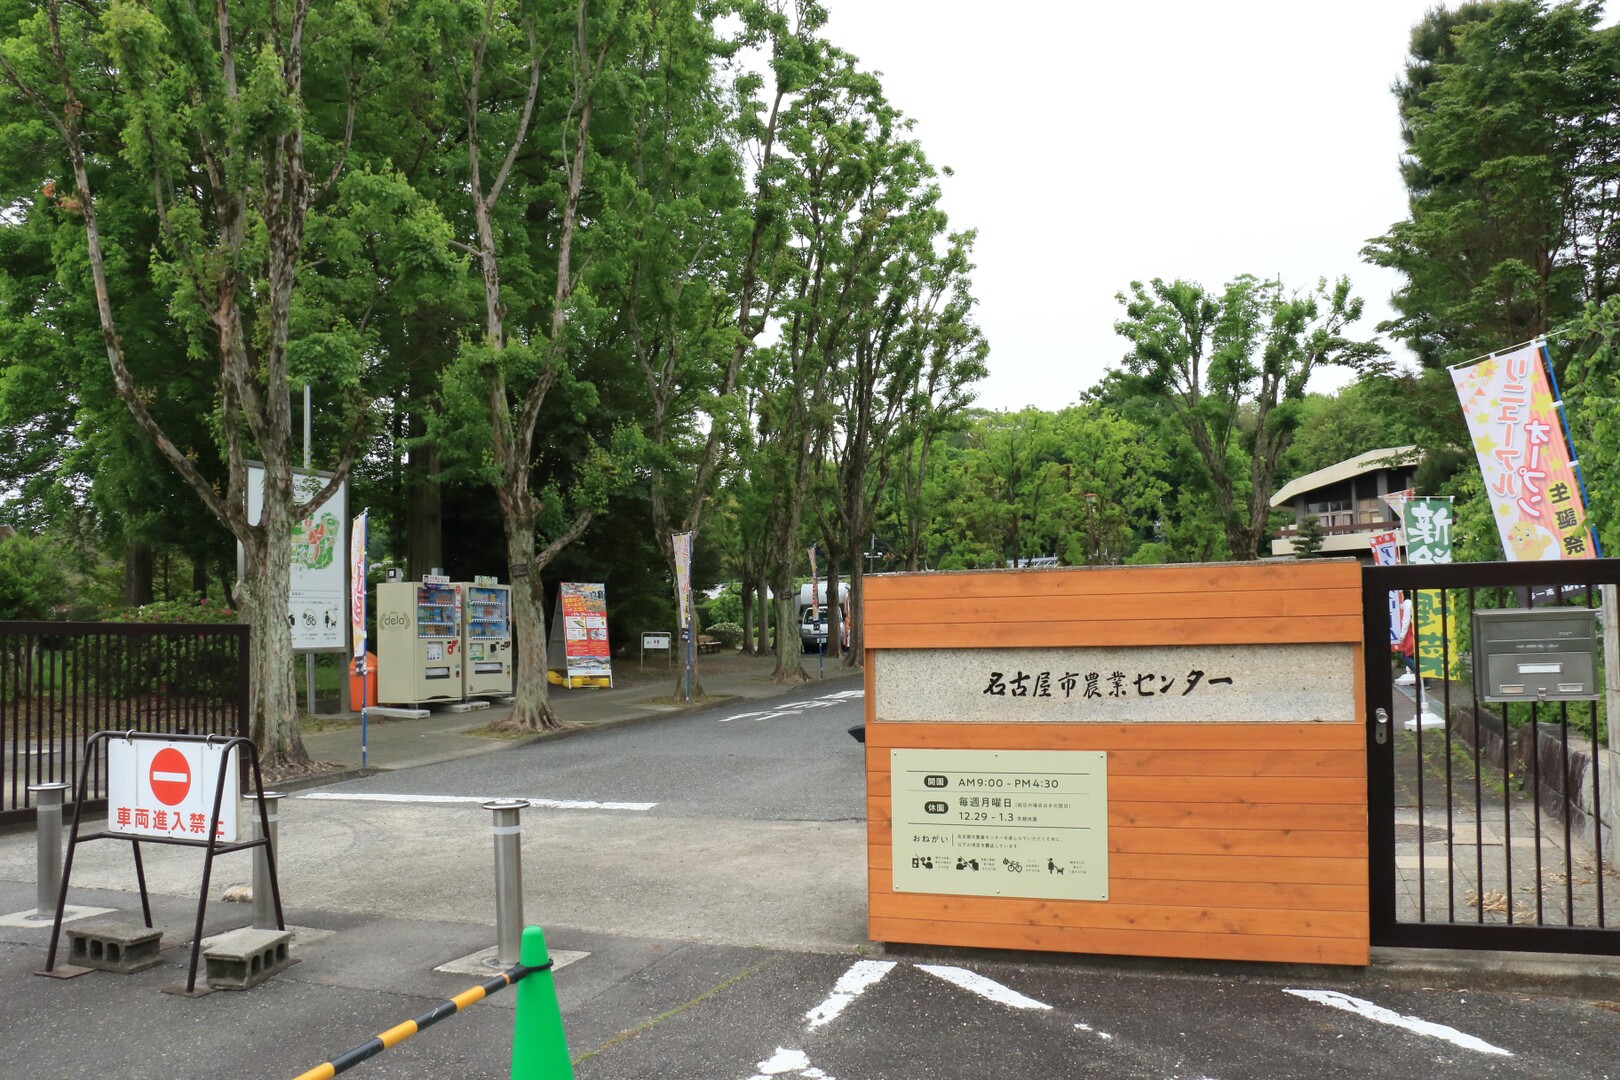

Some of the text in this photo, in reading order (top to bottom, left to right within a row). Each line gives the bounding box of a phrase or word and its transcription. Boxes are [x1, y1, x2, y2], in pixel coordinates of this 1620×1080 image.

[384, 615, 405, 625] dela
[982, 668, 1234, 699] 名古屋市農業センター
[927, 777, 945, 786] 開園
[958, 797, 1012, 808] 毎週月曜日
[928, 803, 945, 813] 休園
[958, 812, 988, 821] 12.29
[999, 813, 1014, 822] 1.3
[912, 834, 949, 844] おねがい
